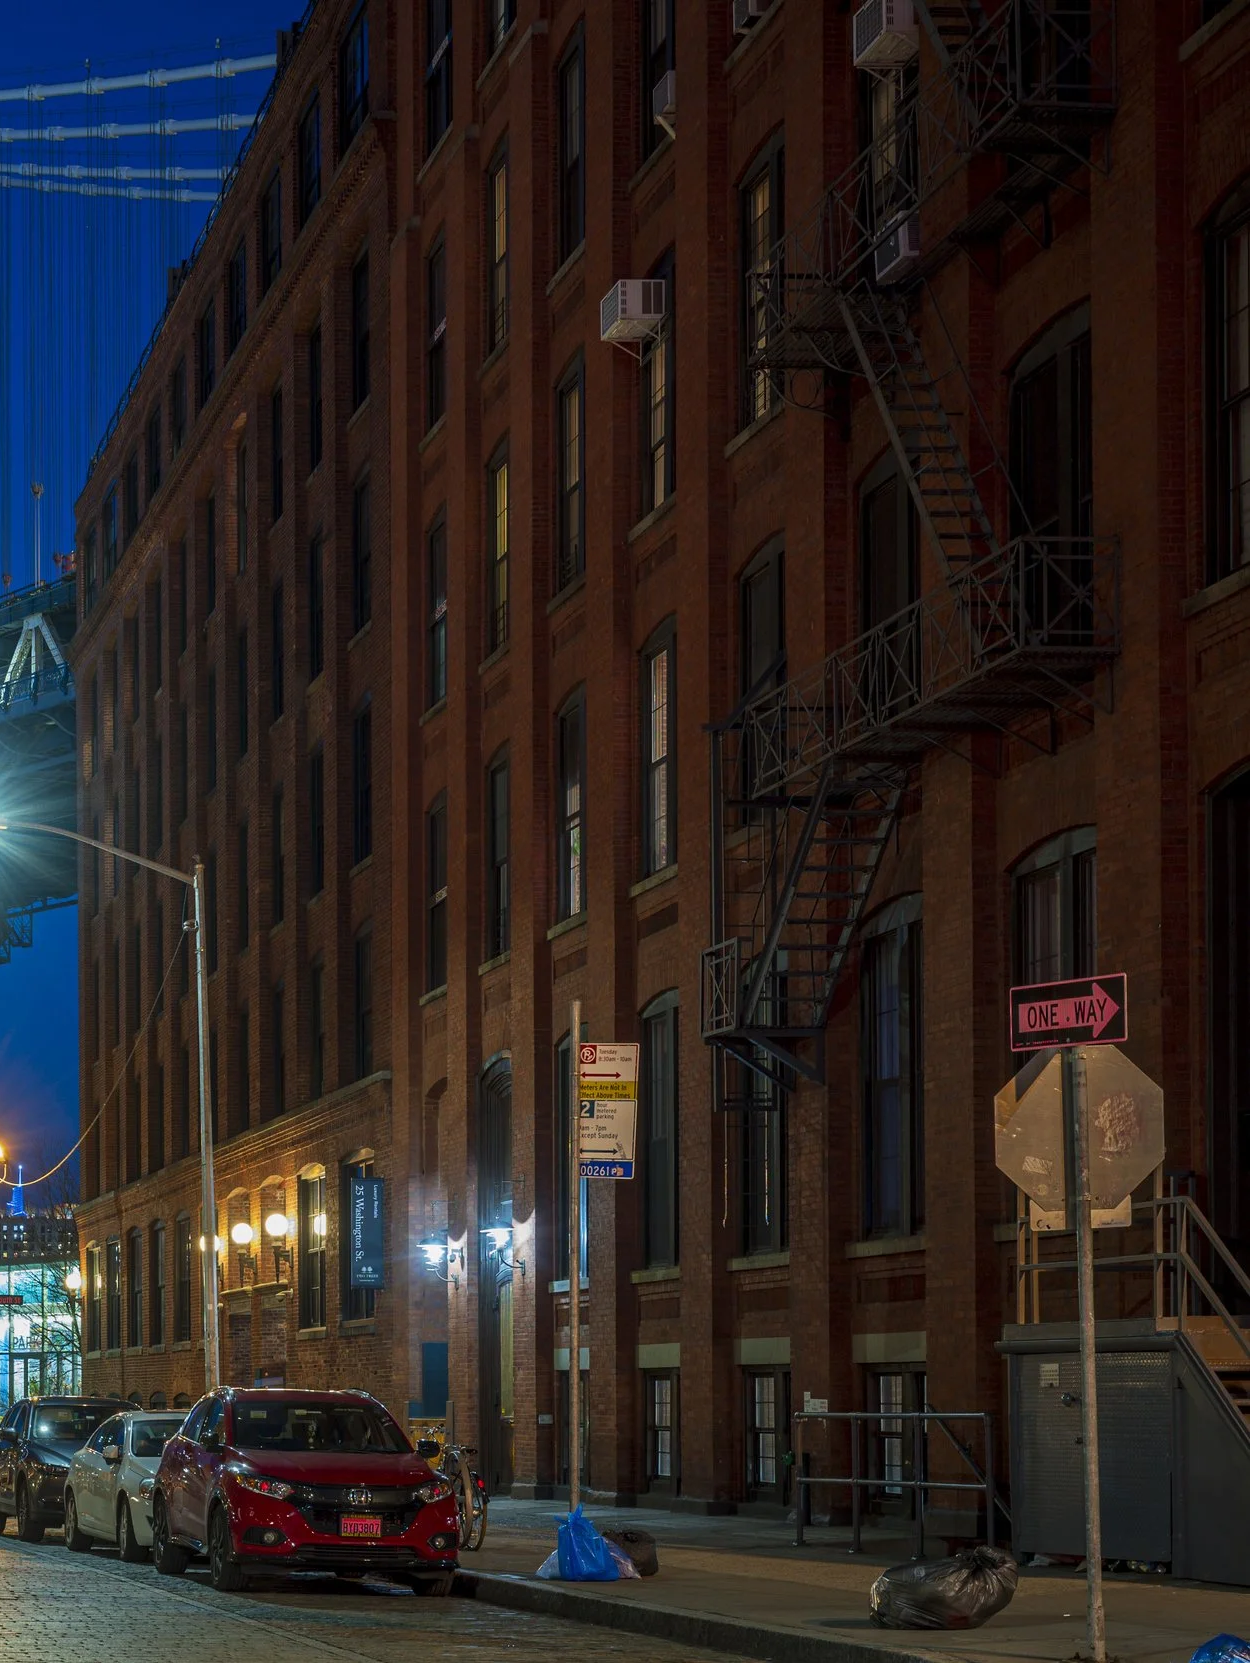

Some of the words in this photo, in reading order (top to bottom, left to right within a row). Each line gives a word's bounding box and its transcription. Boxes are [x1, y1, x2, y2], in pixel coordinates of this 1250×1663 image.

[1027, 1003, 1060, 1029] ONE
[1074, 997, 1108, 1025] WAY
[580, 1101, 591, 1115] 2
[355, 1185, 364, 1196] 25
[352, 1198, 365, 1249] Washington
[355, 1250, 365, 1262] St.
